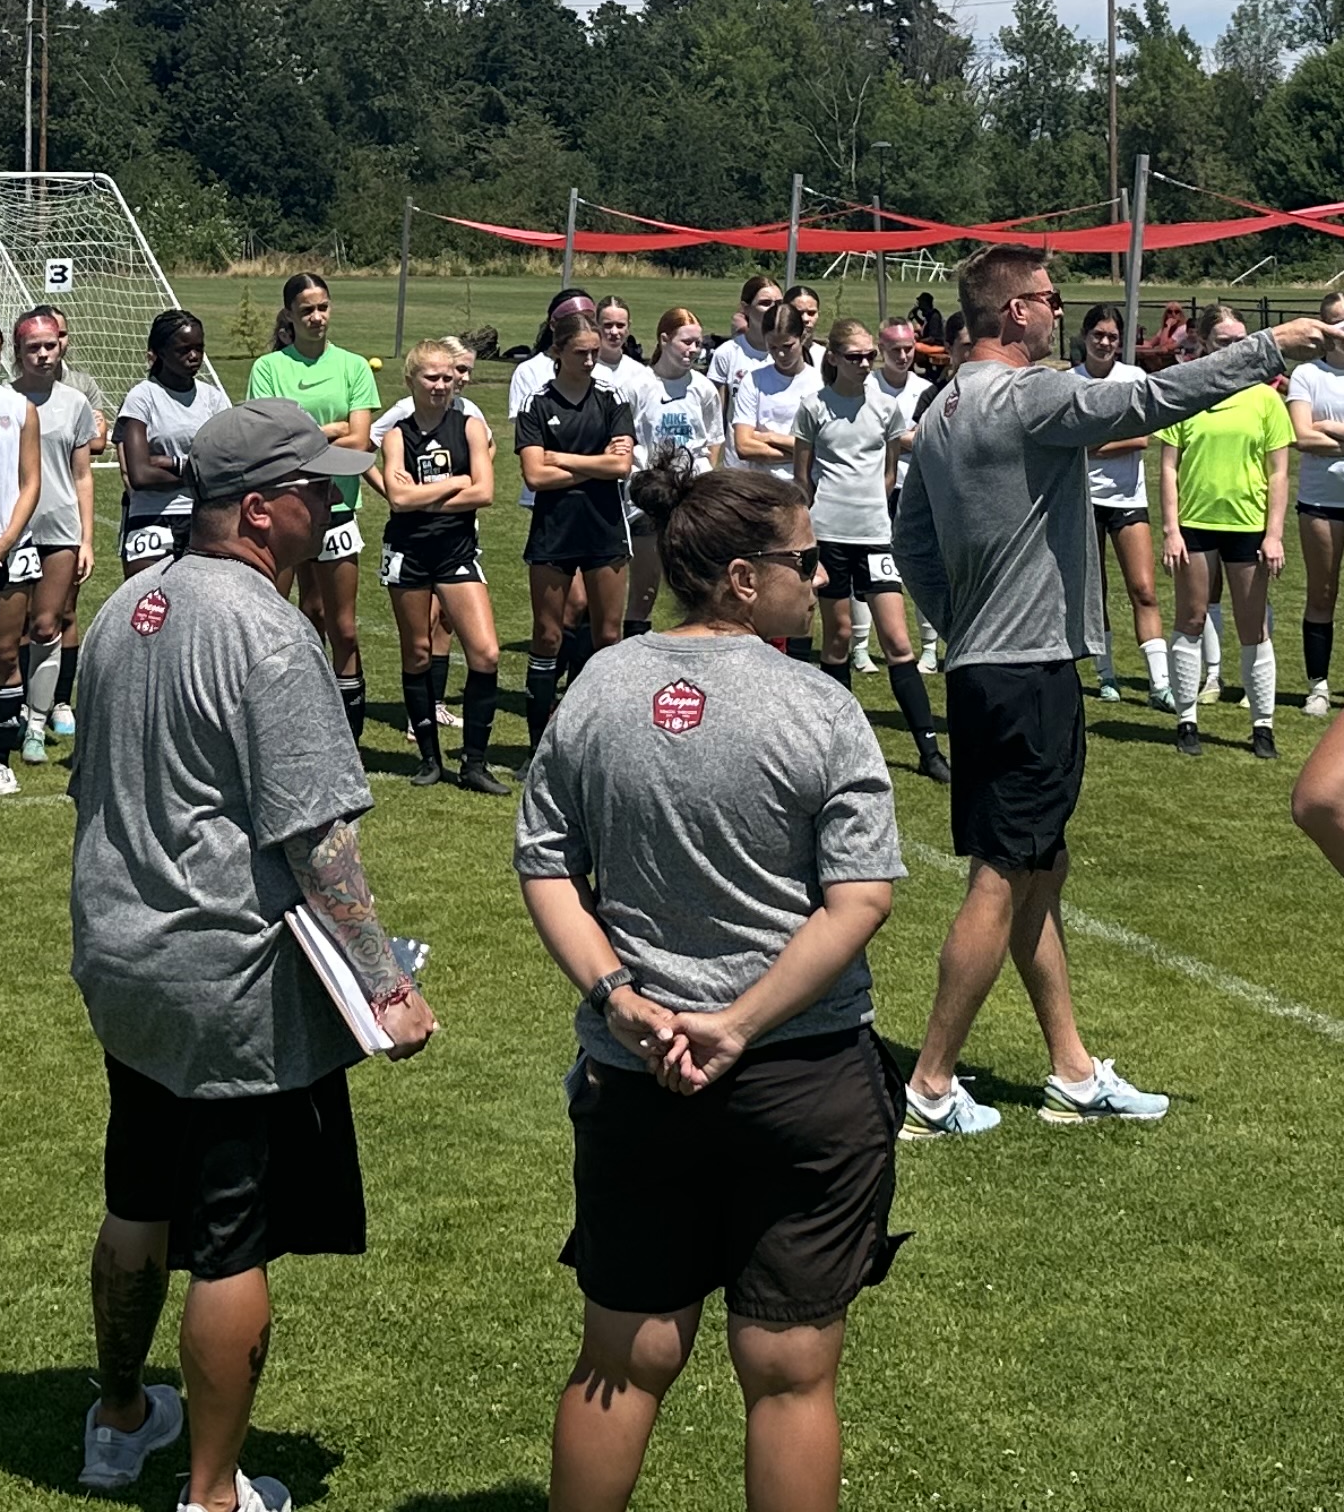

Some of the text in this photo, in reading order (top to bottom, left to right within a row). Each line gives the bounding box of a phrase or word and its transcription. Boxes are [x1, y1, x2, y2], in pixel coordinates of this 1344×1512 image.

[49, 264, 68, 284] 3
[662, 412, 687, 425] NIKE
[134, 532, 161, 554] 60
[326, 530, 352, 555] 40
[18, 553, 42, 576] 23
[658, 692, 701, 709] Oregon
